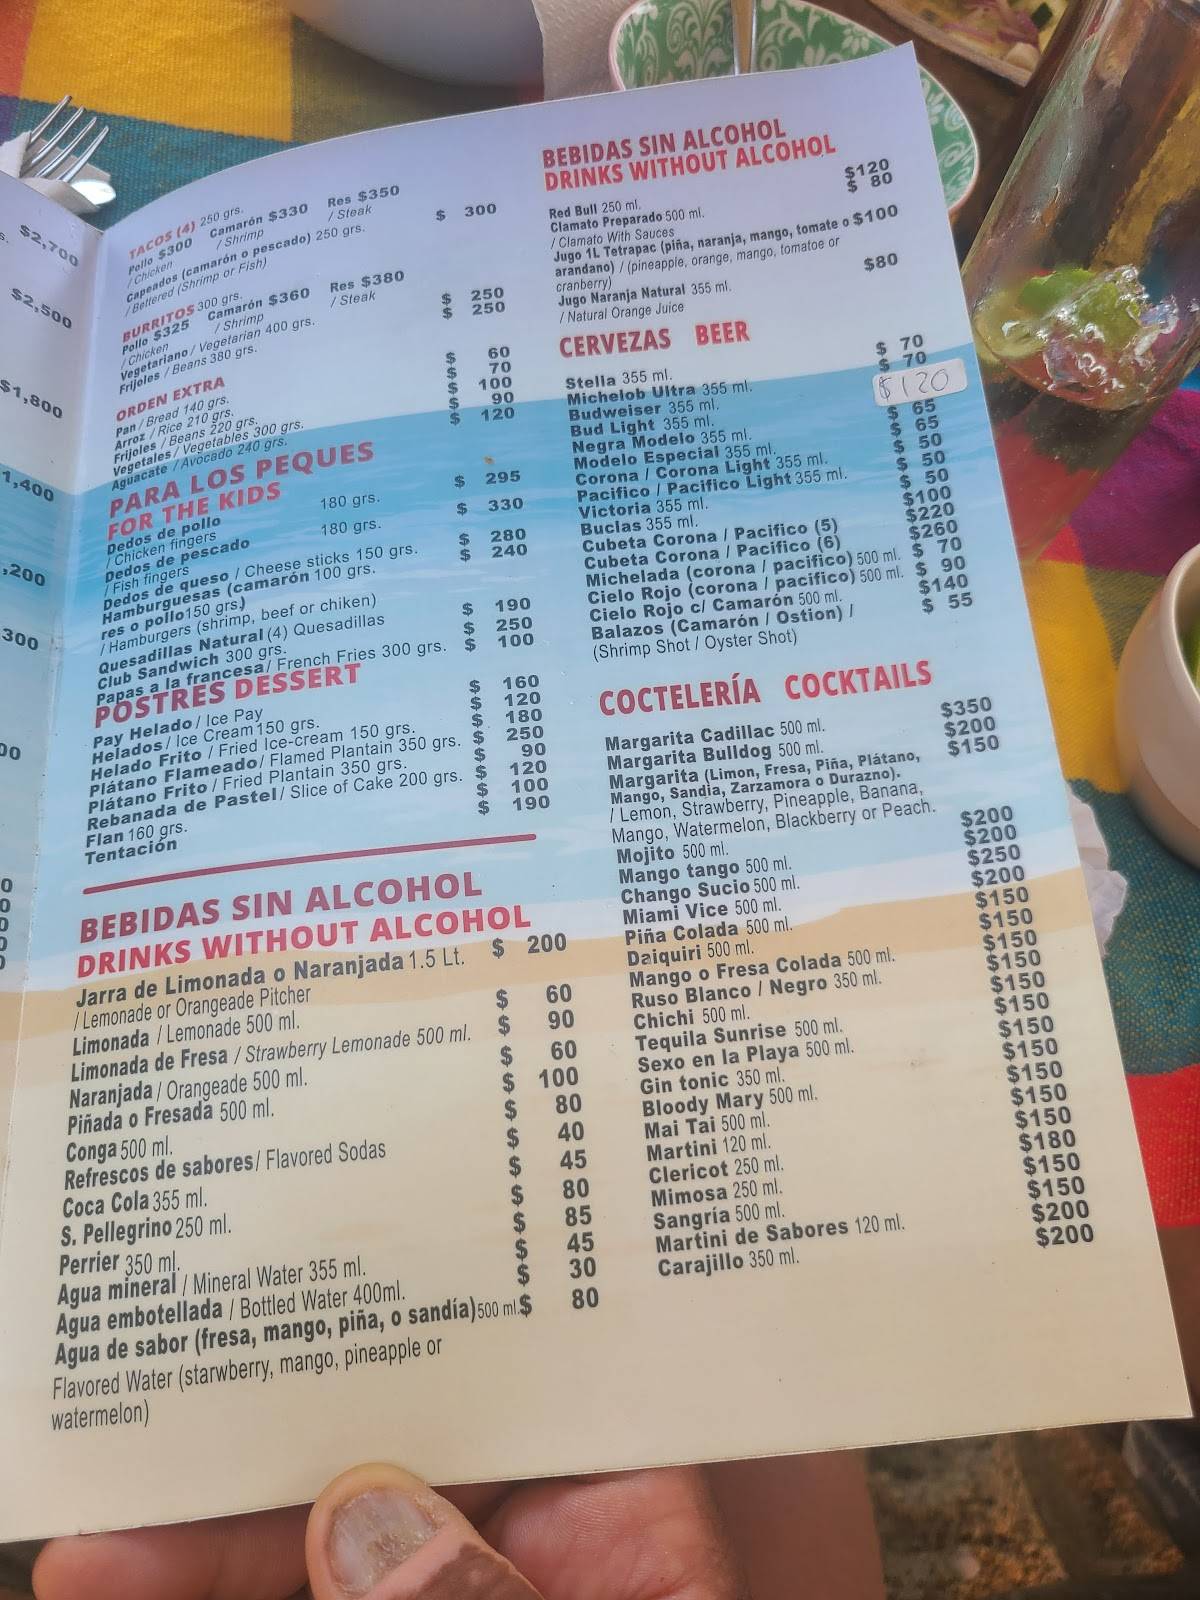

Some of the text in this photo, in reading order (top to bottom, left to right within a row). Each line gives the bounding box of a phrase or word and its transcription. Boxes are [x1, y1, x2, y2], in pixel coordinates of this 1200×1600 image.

[541, 118, 787, 169] BEBIDAS SIN ALCOHOL
[545, 133, 836, 192] DRINKS WITHOUT ALCOHOL
[845, 157, 890, 180] $120
[328, 185, 400, 208] Res $350
[464, 204, 497, 217] 300
[549, 198, 641, 219] Red Bull 250 ml.
[852, 204, 898, 226] $100
[18, 223, 80, 268] $2,700
[128, 207, 244, 260] TACOS (4) 250 grs.
[128, 204, 308, 275] Pollo $300 Camarón $330
[127, 224, 365, 303] Capeados (camarón o pescado) 250 grs.
[556, 276, 612, 293] cranberry)
[557, 280, 732, 310] Jugo Naranja Natural 355 ml.
[11, 287, 73, 330] $2,500
[123, 292, 243, 341] BURRITOS 300 grs.
[560, 319, 750, 359] CERVEZAS BEER
[566, 368, 672, 389] Stella 355 ml.
[0, 378, 64, 420] $1,800
[116, 377, 225, 421] ORDEN EXTRA
[572, 427, 752, 454] Negra Modelo 355 ml.
[109, 442, 375, 519] PARA LOS PEQUES
[486, 470, 521, 485] 295
[108, 482, 281, 541] FOR THE KIDS
[107, 516, 221, 555] Dedos de pollo
[909, 519, 958, 541] $260
[99, 615, 385, 675] Quesadillas Natural (4) Quesadillas
[97, 645, 287, 690] Club Sandwich 300 grs.
[503, 675, 539, 690] 160
[95, 663, 361, 728] POSTRES DESSERT
[599, 659, 932, 717] COCTELERÍA COCKTAILS
[940, 696, 993, 719] $350
[605, 719, 826, 751] Margarita Cadillac 500 ml.
[609, 749, 920, 791] Margarita (Limon, Fresa, Piña, Plátano,
[513, 795, 550, 811] 190
[85, 839, 177, 865] Tentación
[86, 821, 188, 848] Flan 160 grs.
[80, 871, 482, 943] BEBIDAS SIN ALCOHOL
[77, 905, 531, 978] DRINKS WITHOUT ALCOHOL
[527, 932, 568, 955] 200
[76, 947, 464, 1008] Jarra de Limonada o Naranjada 1.5 Lt.
[635, 1017, 843, 1053] Tequila Sunrise 500 ml.
[539, 1067, 580, 1089] 100
[68, 1099, 275, 1136] Piñada o Fresada 500 ml.
[61, 1215, 231, 1248] S. Pellegrino 250 ml.
[1036, 1223, 1094, 1247] $200
[658, 1247, 799, 1277] Carajillo 350 ml.
[572, 1287, 599, 1310] 80
[56, 1295, 520, 1368] Agua de sabor (fresa, mango, piña, o sandía) 500 ml.
[52, 1337, 442, 1401] Flavored Water (starwberry, mango, pineapple or
[51, 1399, 149, 1434] watermelon)
